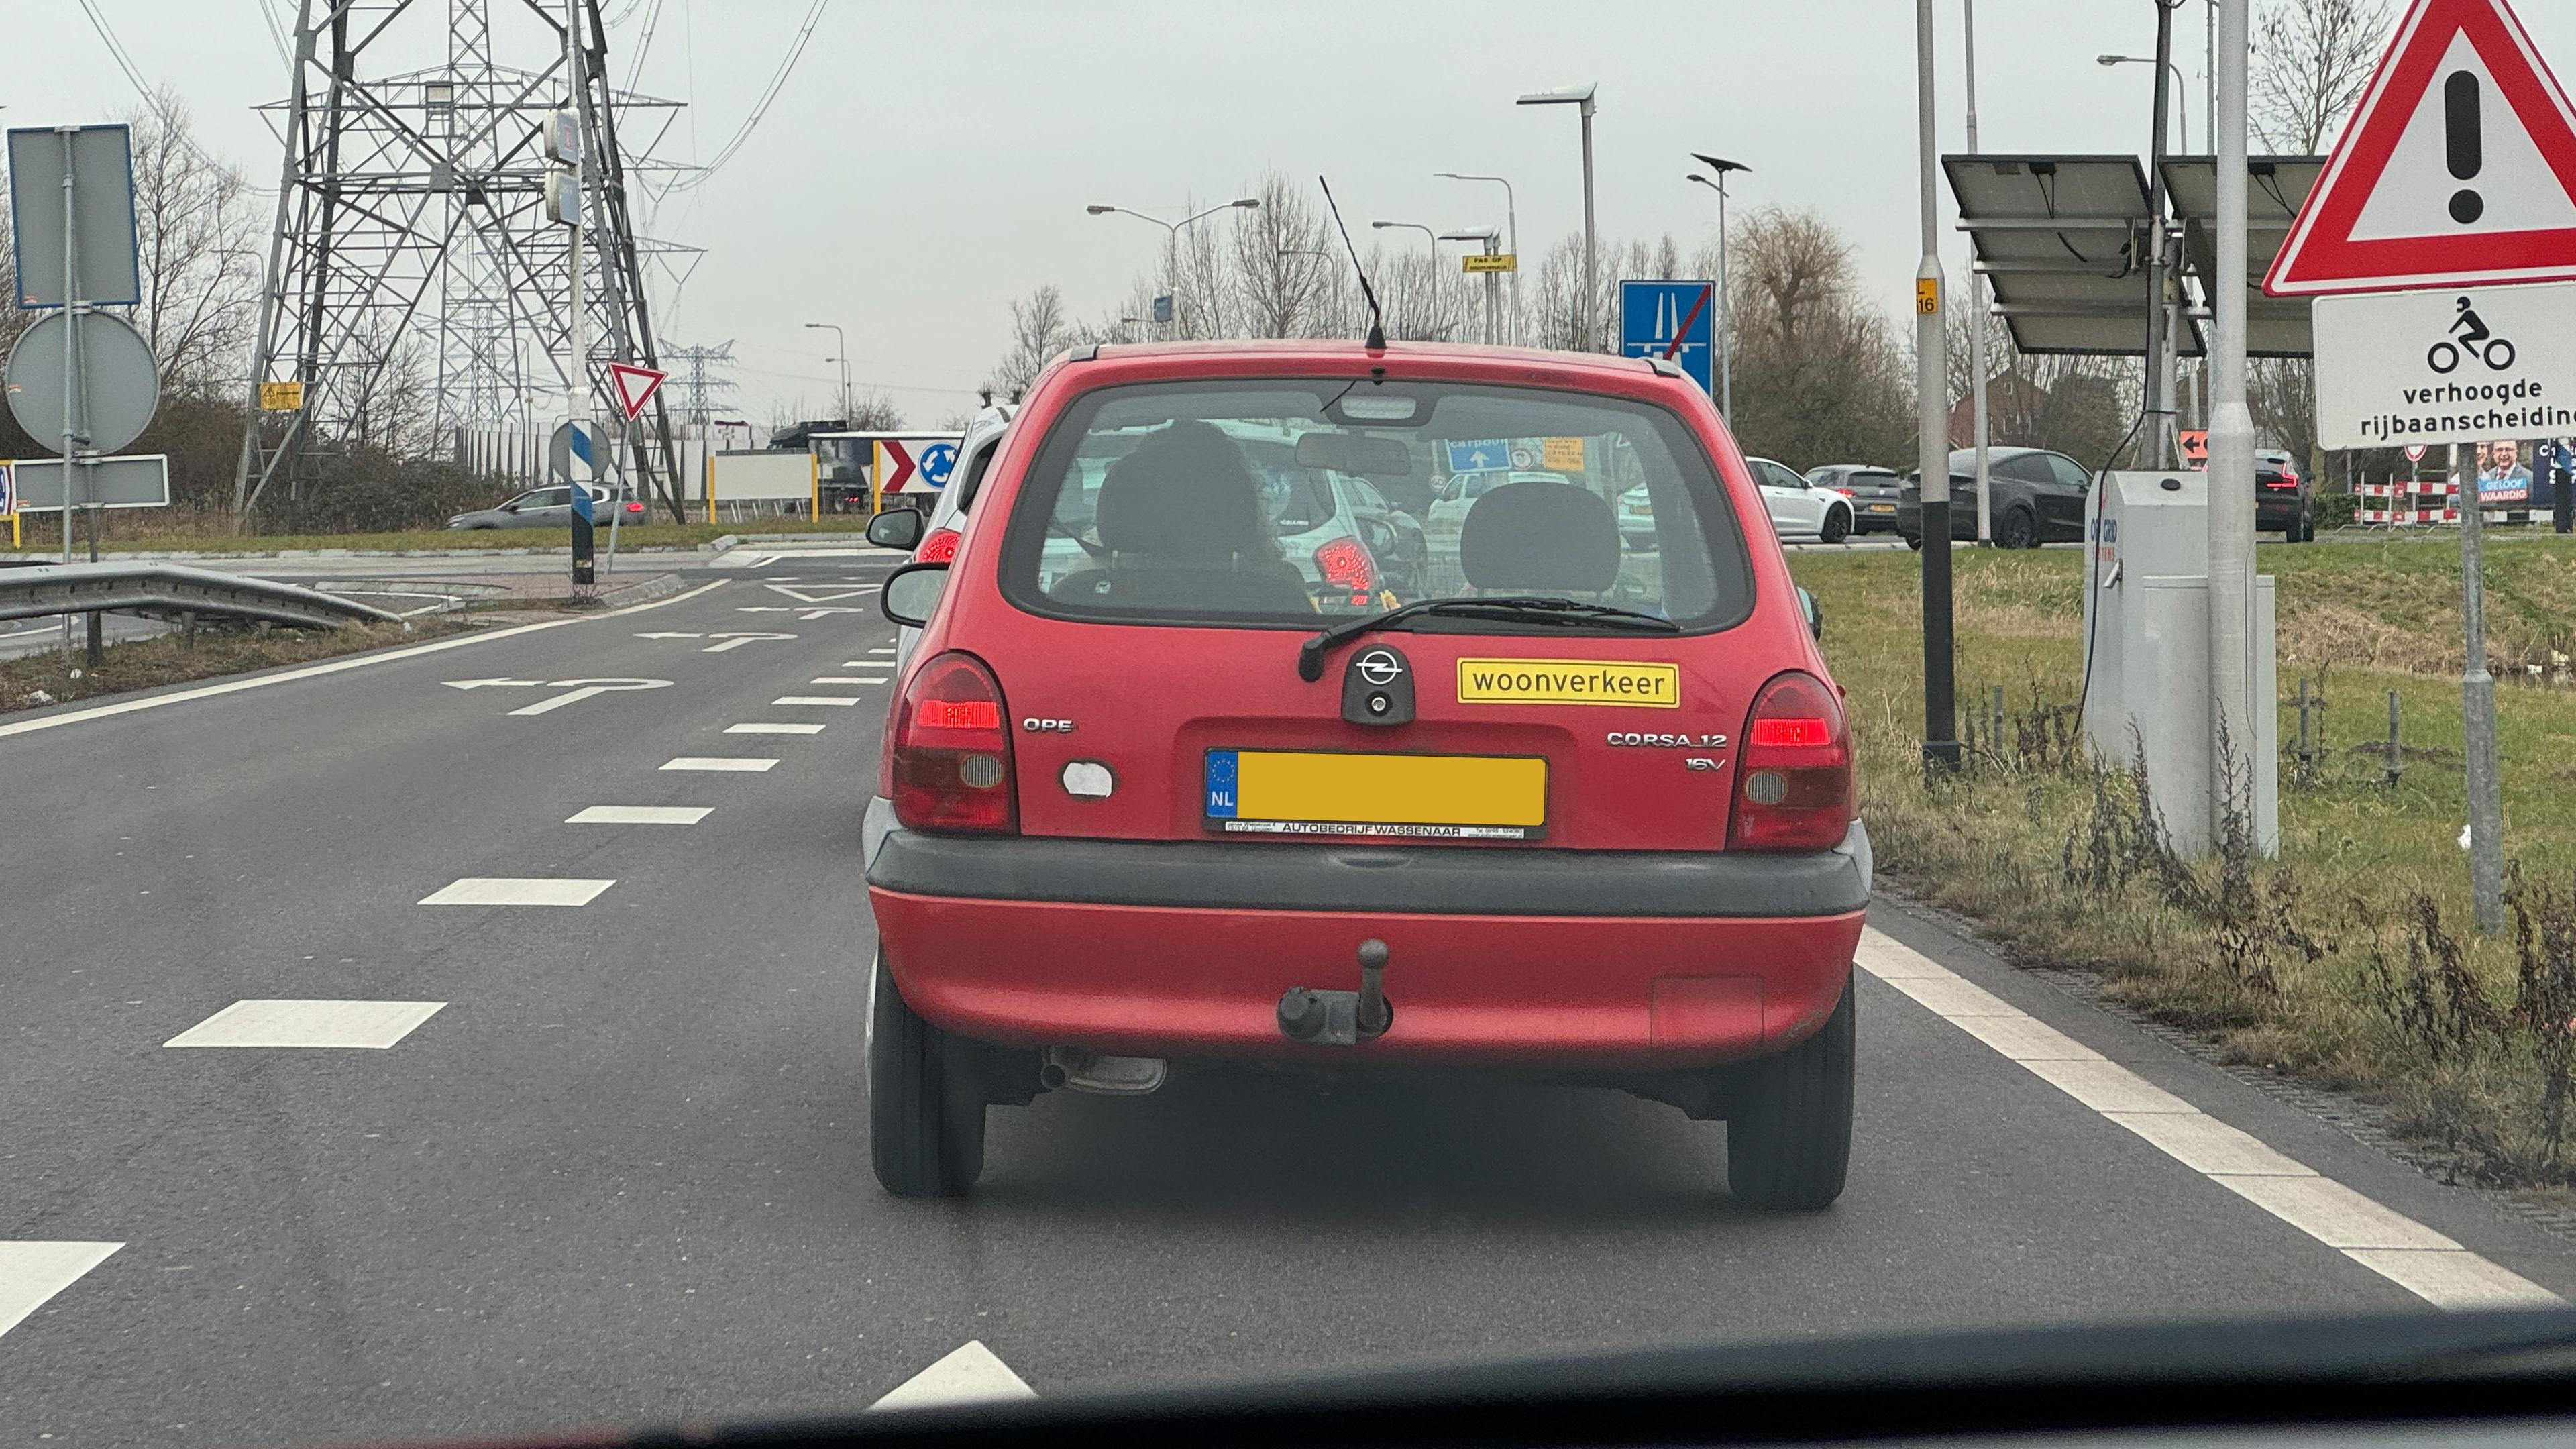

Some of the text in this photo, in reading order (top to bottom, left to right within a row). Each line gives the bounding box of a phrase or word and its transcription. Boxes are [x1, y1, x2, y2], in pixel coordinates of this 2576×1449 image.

[2403, 378, 2542, 405] verhoogde
[2486, 480, 2523, 490] GELOOF
[2481, 490, 2527, 501] WAARDIG
[1472, 669, 1665, 695] woonverkeer
[1023, 718, 1073, 733] OPE
[1607, 731, 1690, 747] CORSA
[1685, 757, 1726, 771] 16V
[1212, 791, 1234, 806] NL
[1282, 822, 1373, 835] AUTOBEDRIJF
[1375, 825, 1461, 837] WASSENAAR
